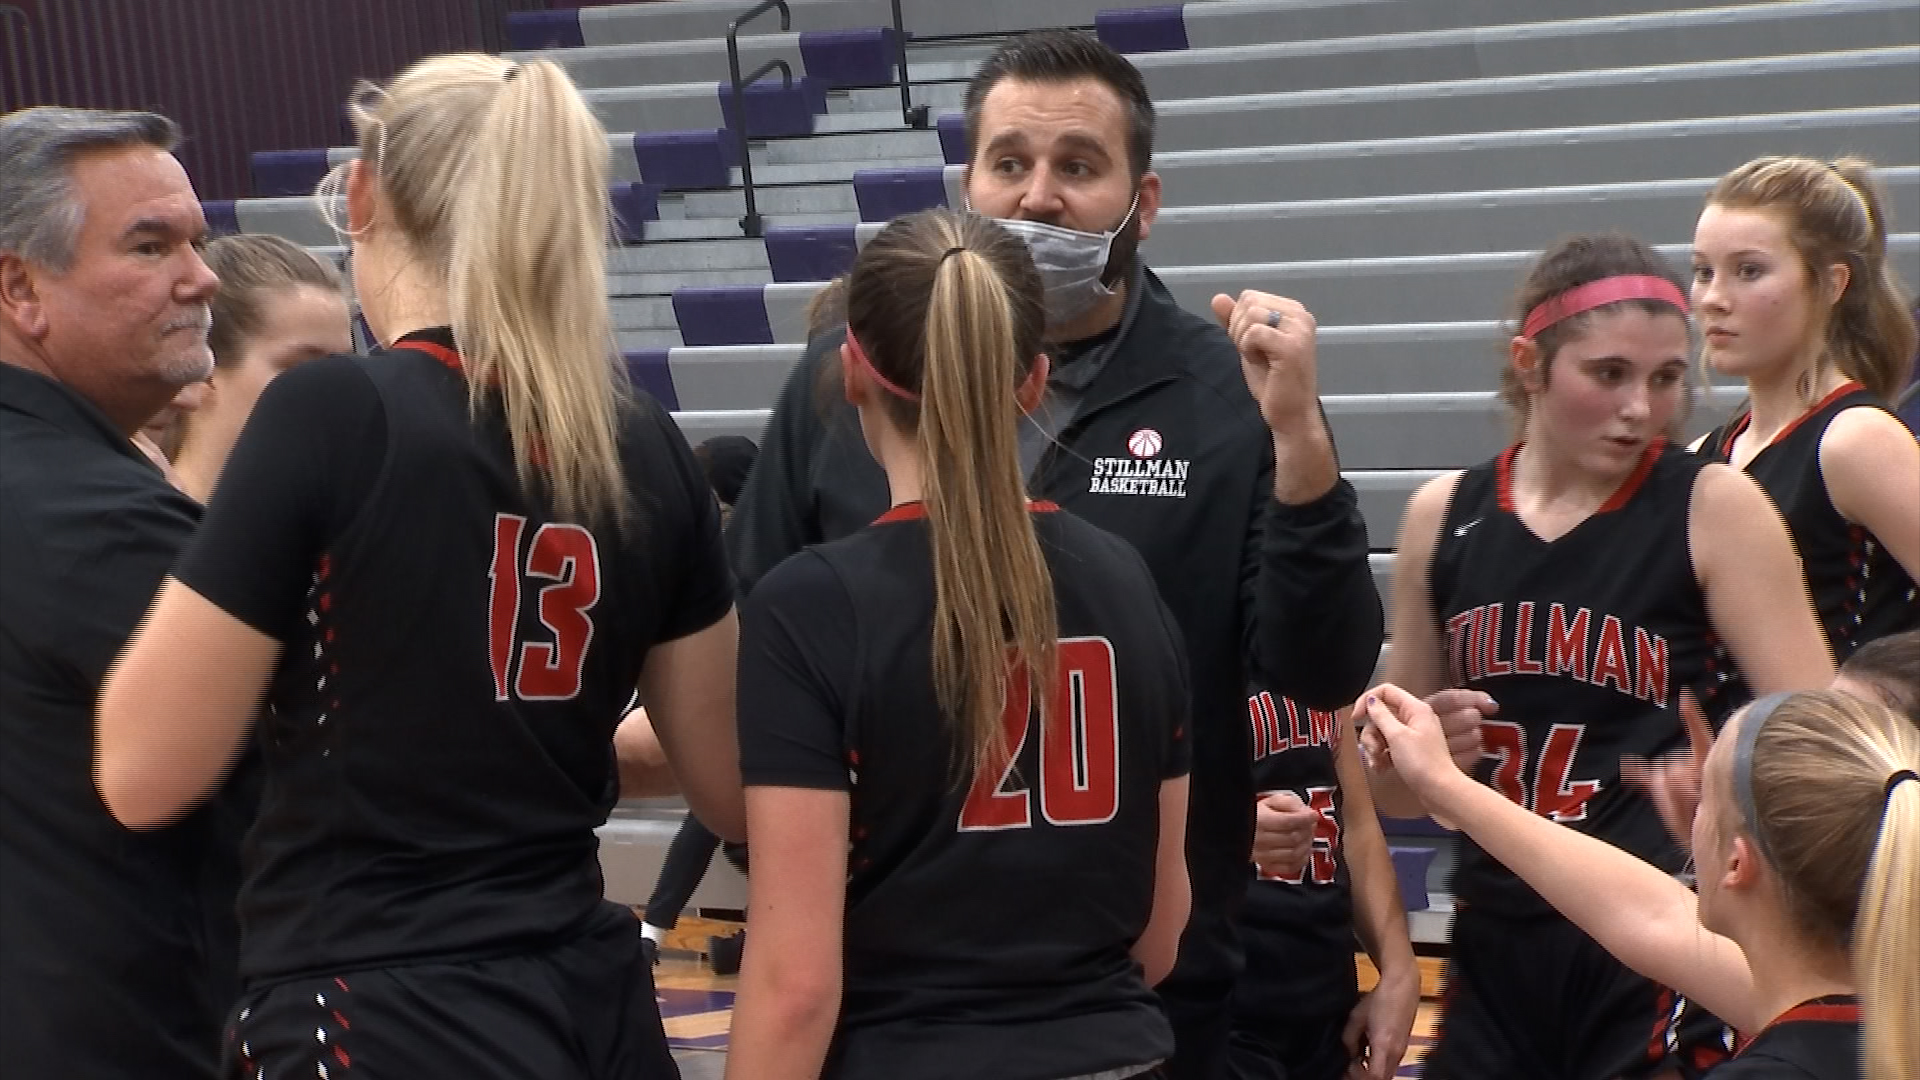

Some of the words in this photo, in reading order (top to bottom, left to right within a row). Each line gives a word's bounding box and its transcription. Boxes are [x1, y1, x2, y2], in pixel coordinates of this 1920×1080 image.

[1089, 477, 1187, 498] BASKETBALL
[1093, 457, 1190, 480] STILLMAN
[488, 512, 601, 702] 13
[957, 635, 1120, 833] 20
[1248, 691, 1342, 761] ILLM
[1480, 720, 1603, 821] 34
[1256, 786, 1340, 885] 5
